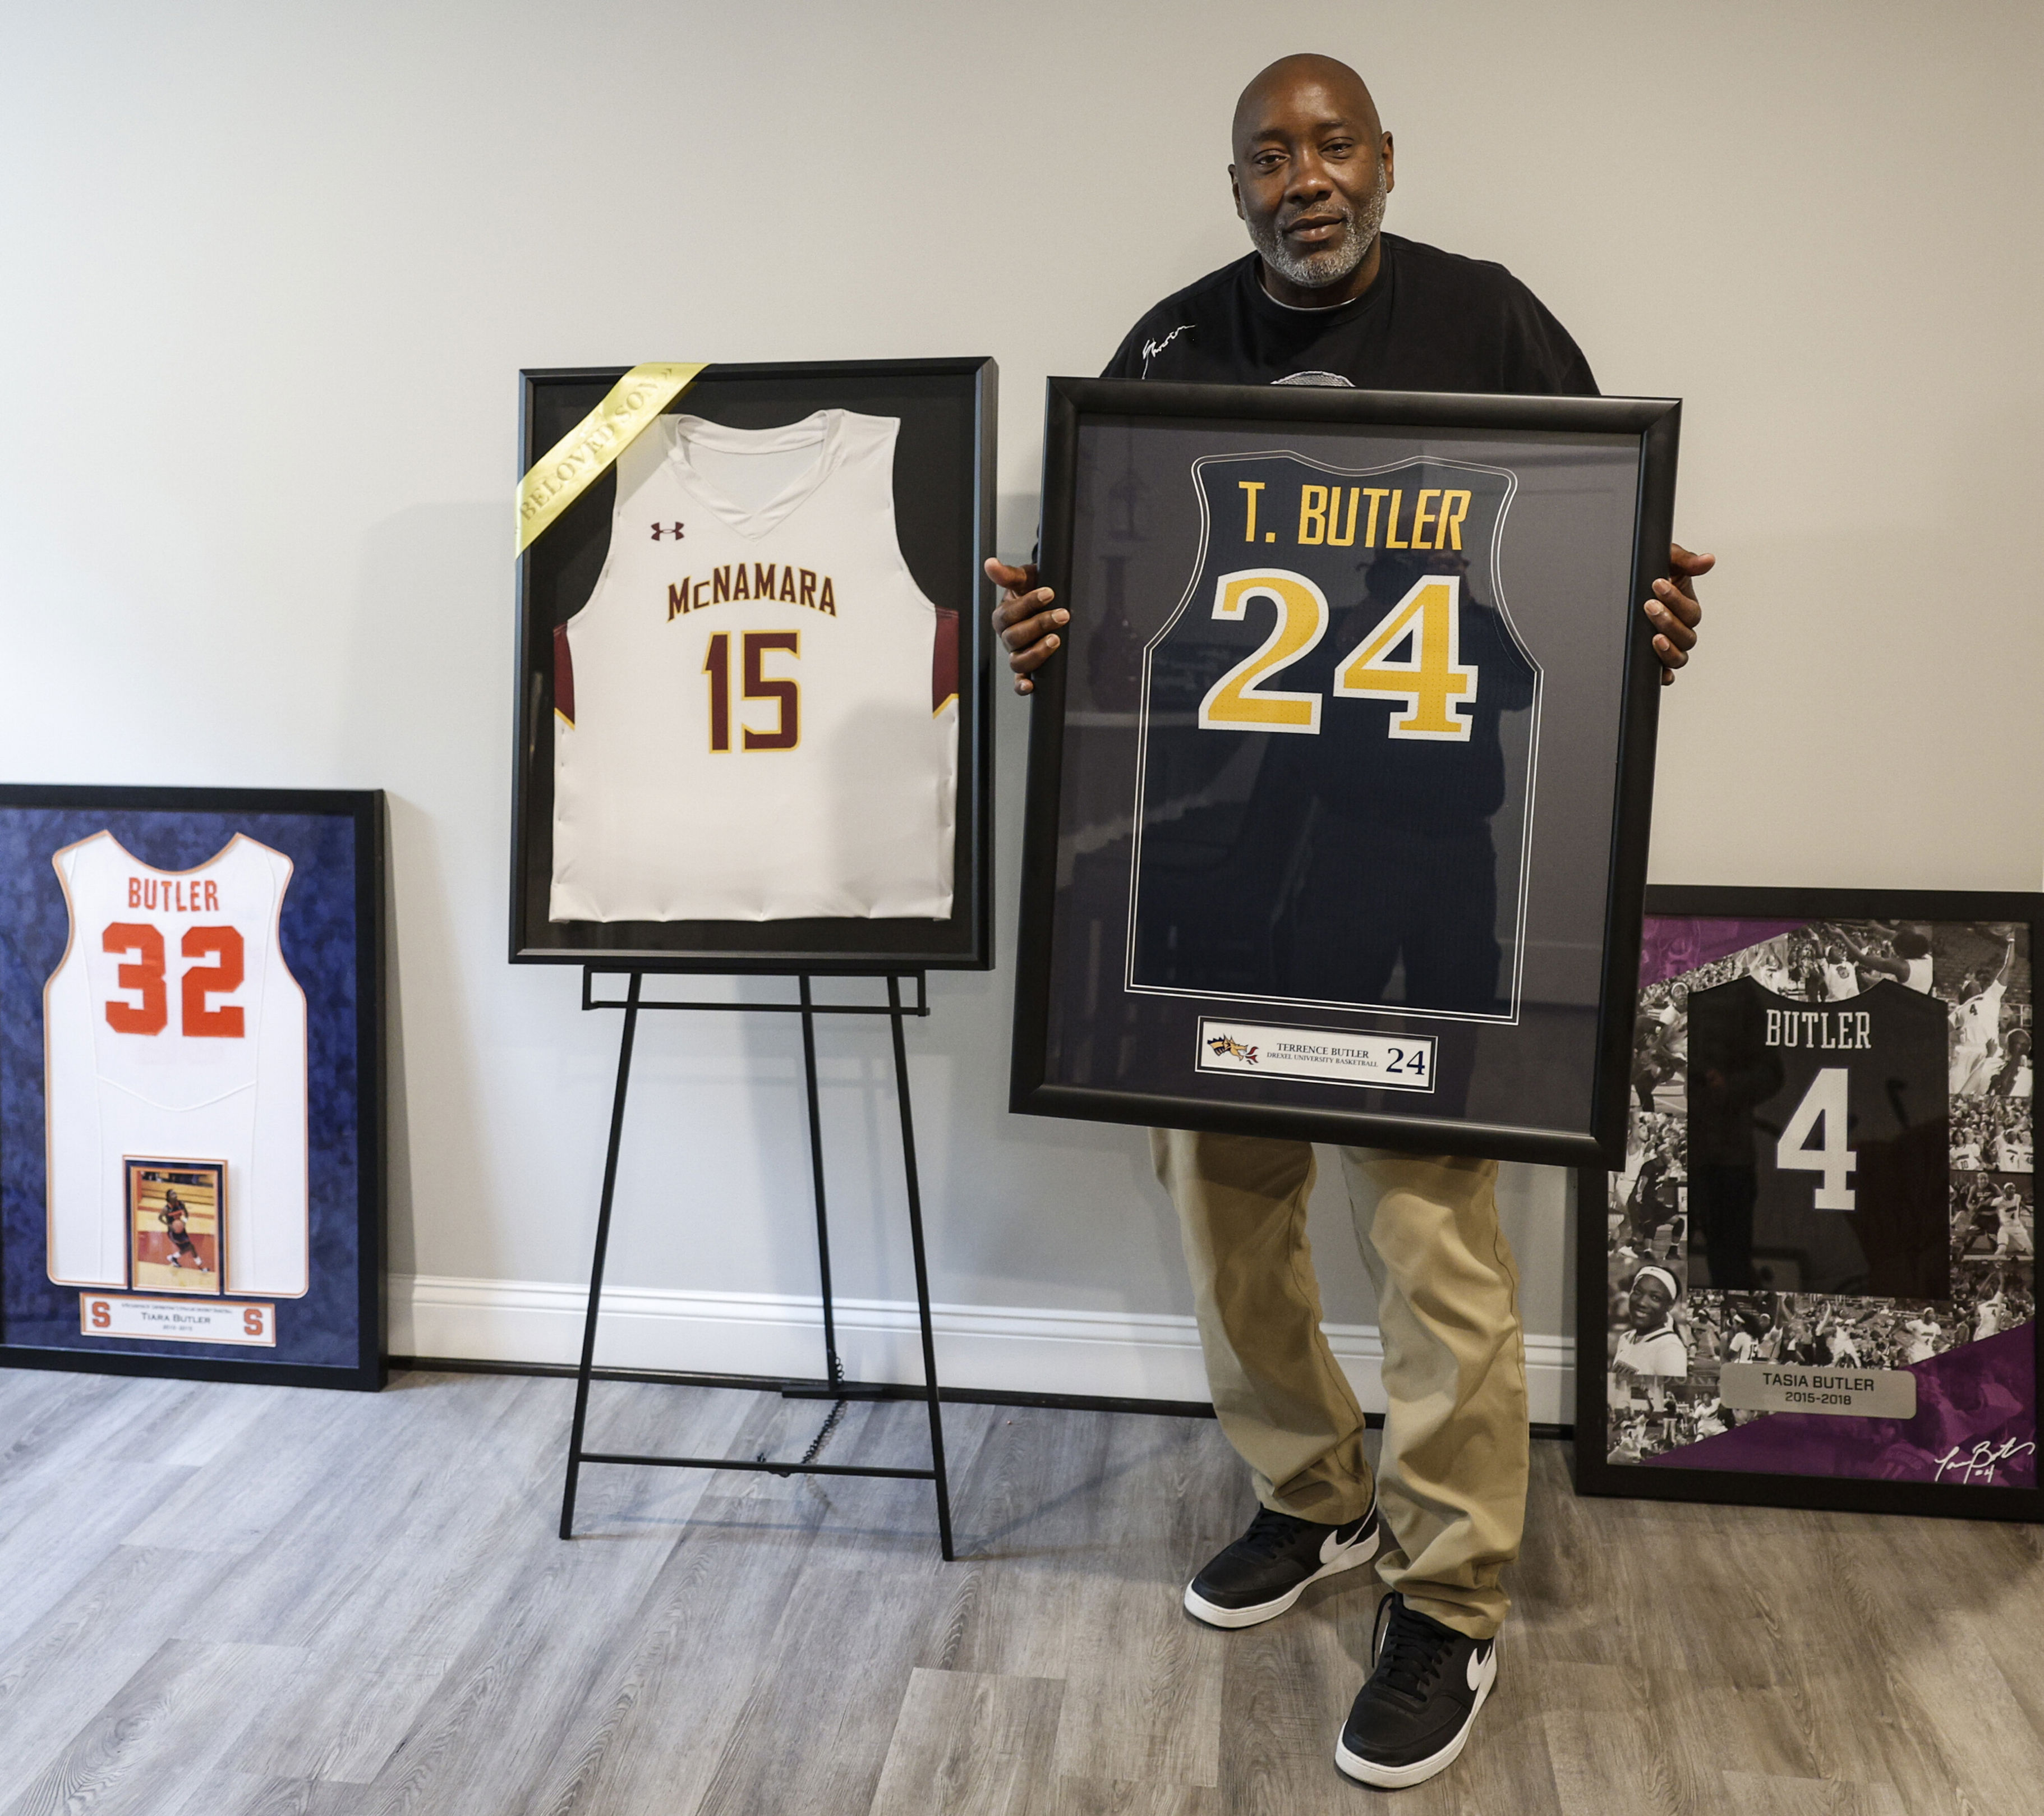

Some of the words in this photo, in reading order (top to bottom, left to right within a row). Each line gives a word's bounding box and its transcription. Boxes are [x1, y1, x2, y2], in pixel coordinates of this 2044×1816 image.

[521, 423, 615, 521] BELOVED
[1239, 481, 1276, 542] T.
[1298, 484, 1472, 550] BUTLER
[1198, 568, 1479, 742] 24
[701, 629, 801, 753] 15
[128, 877, 219, 913] BUTLER
[103, 922, 245, 1038] 32
[1765, 1009, 1872, 1049] BUTLER
[1277, 1043, 1329, 1055] TERRENCE
[1331, 1048, 1369, 1059] BUTLER
[1294, 1054, 1334, 1064] UNIVERSITY
[1335, 1058, 1378, 1067] BASKETBALL
[1385, 1047, 1425, 1075] 24
[1776, 1068, 1857, 1211] 4
[1763, 1373, 1808, 1387] TASIA
[1812, 1377, 1874, 1391] BUTLER
[1785, 1391, 1852, 1405] 2015-2018
